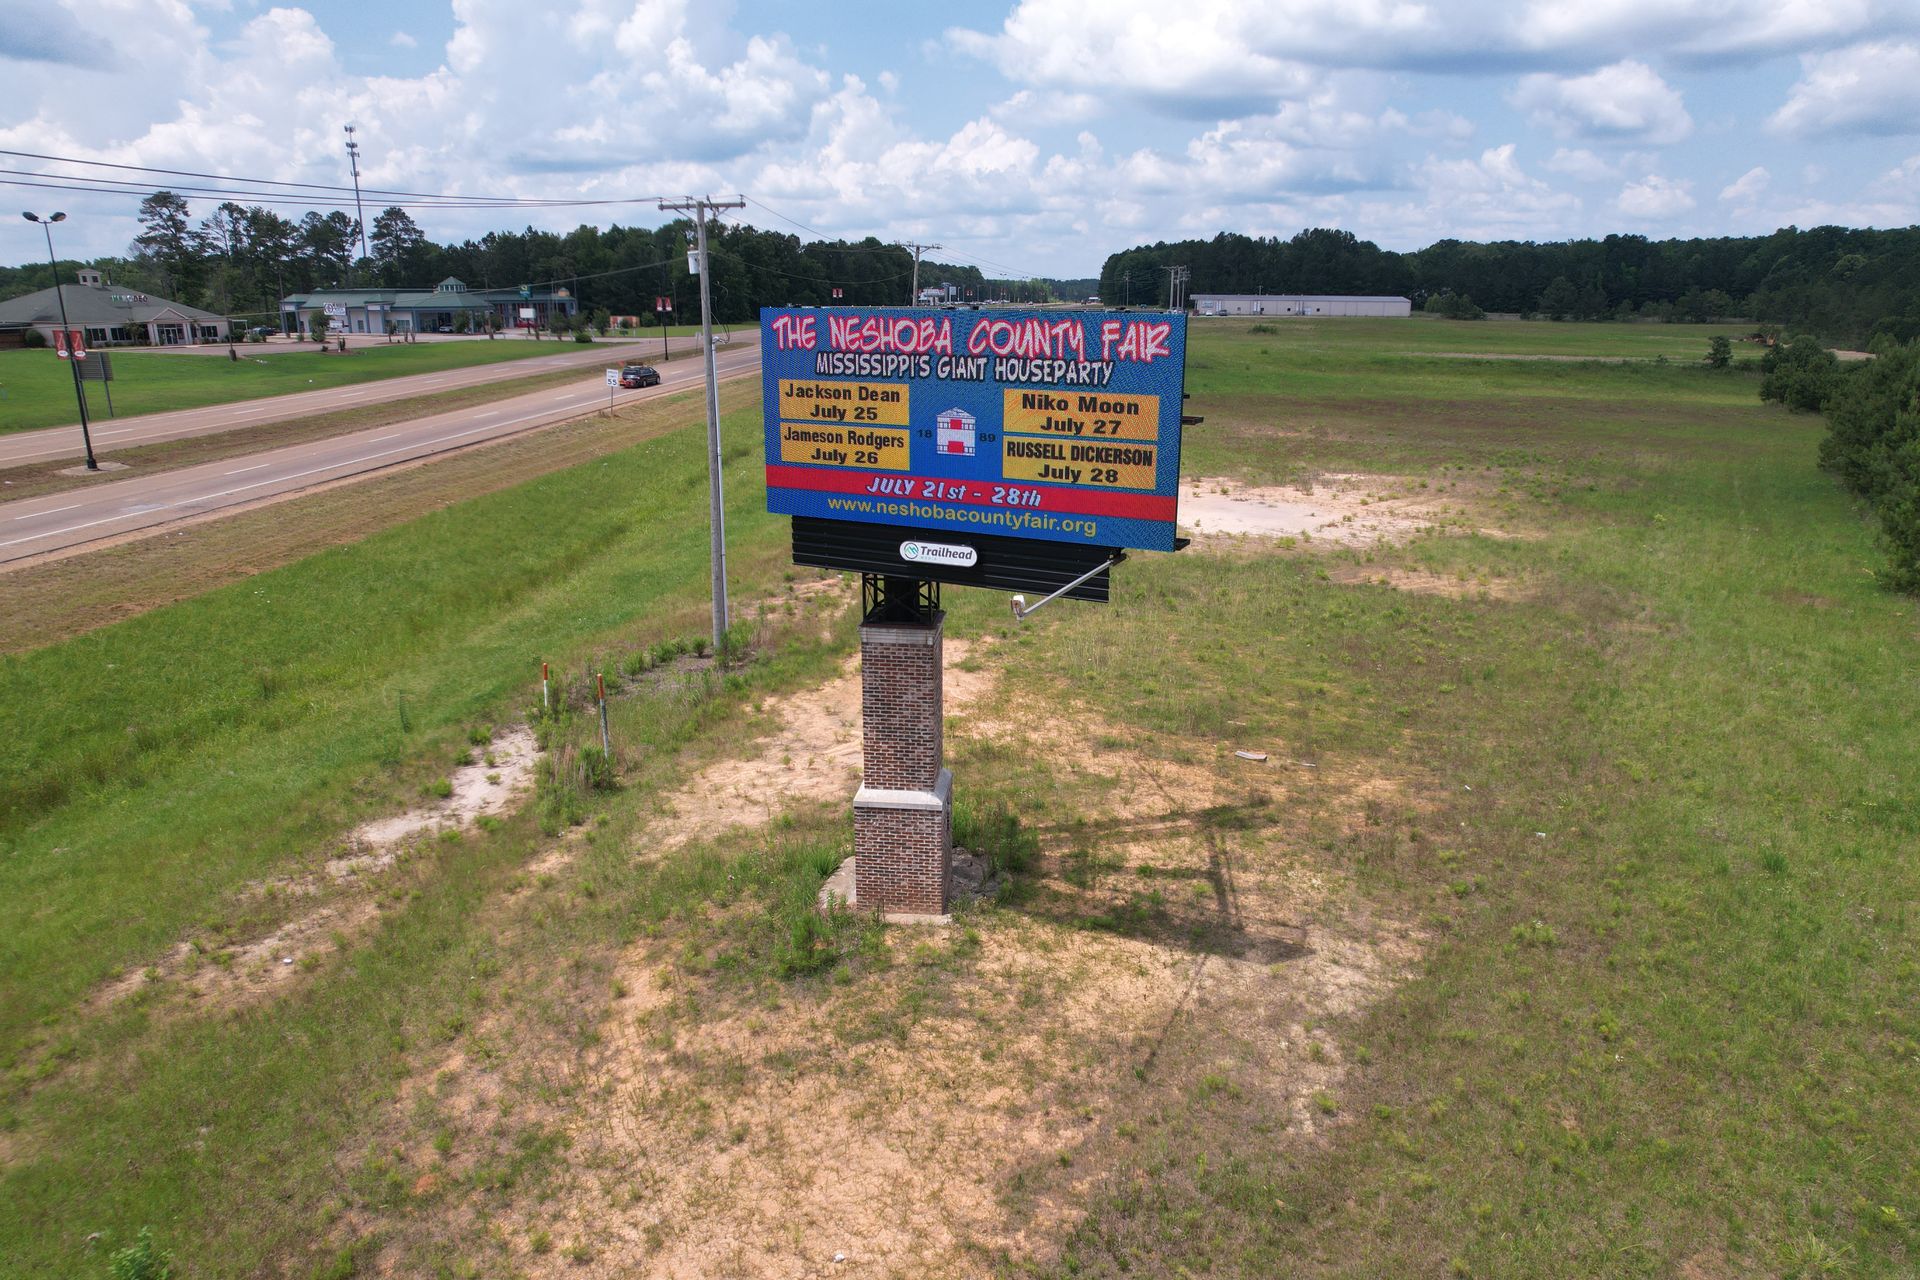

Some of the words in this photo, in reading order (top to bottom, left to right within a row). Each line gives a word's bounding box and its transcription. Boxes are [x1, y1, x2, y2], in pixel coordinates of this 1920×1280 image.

[772, 315, 816, 350] THE
[828, 315, 952, 354] NESHOBA
[969, 318, 1085, 363] COUNTY
[1102, 321, 1171, 362] FAIR
[816, 352, 930, 378] MISSISSIPPI'S
[937, 356, 988, 381] GIANT
[995, 357, 1114, 385] HOUSEPARTY
[785, 383, 852, 401] Jackson
[858, 386, 900, 403] Dean
[811, 405, 847, 422] July
[854, 406, 878, 420] 25
[1022, 394, 1069, 411] Niko
[1078, 396, 1139, 415] Moon
[917, 429, 932, 438] 18
[1040, 416, 1085, 436] July
[1093, 419, 1122, 434] 27
[784, 427, 843, 444] Jameson
[848, 430, 904, 450] Rodgers
[979, 433, 996, 442] 89
[811, 448, 847, 465] July
[854, 451, 878, 464] 26
[1006, 441, 1066, 461] RUSSELL
[1071, 445, 1153, 466] DICKERSON
[1038, 464, 1082, 484] July
[1090, 468, 1119, 483] 28
[866, 477, 915, 495] JULY
[921, 480, 967, 500] 21st
[991, 486, 1041, 507] 28th
[827, 498, 1097, 537] www.neshobacountyfair.org
[921, 546, 973, 560] Trailhead
